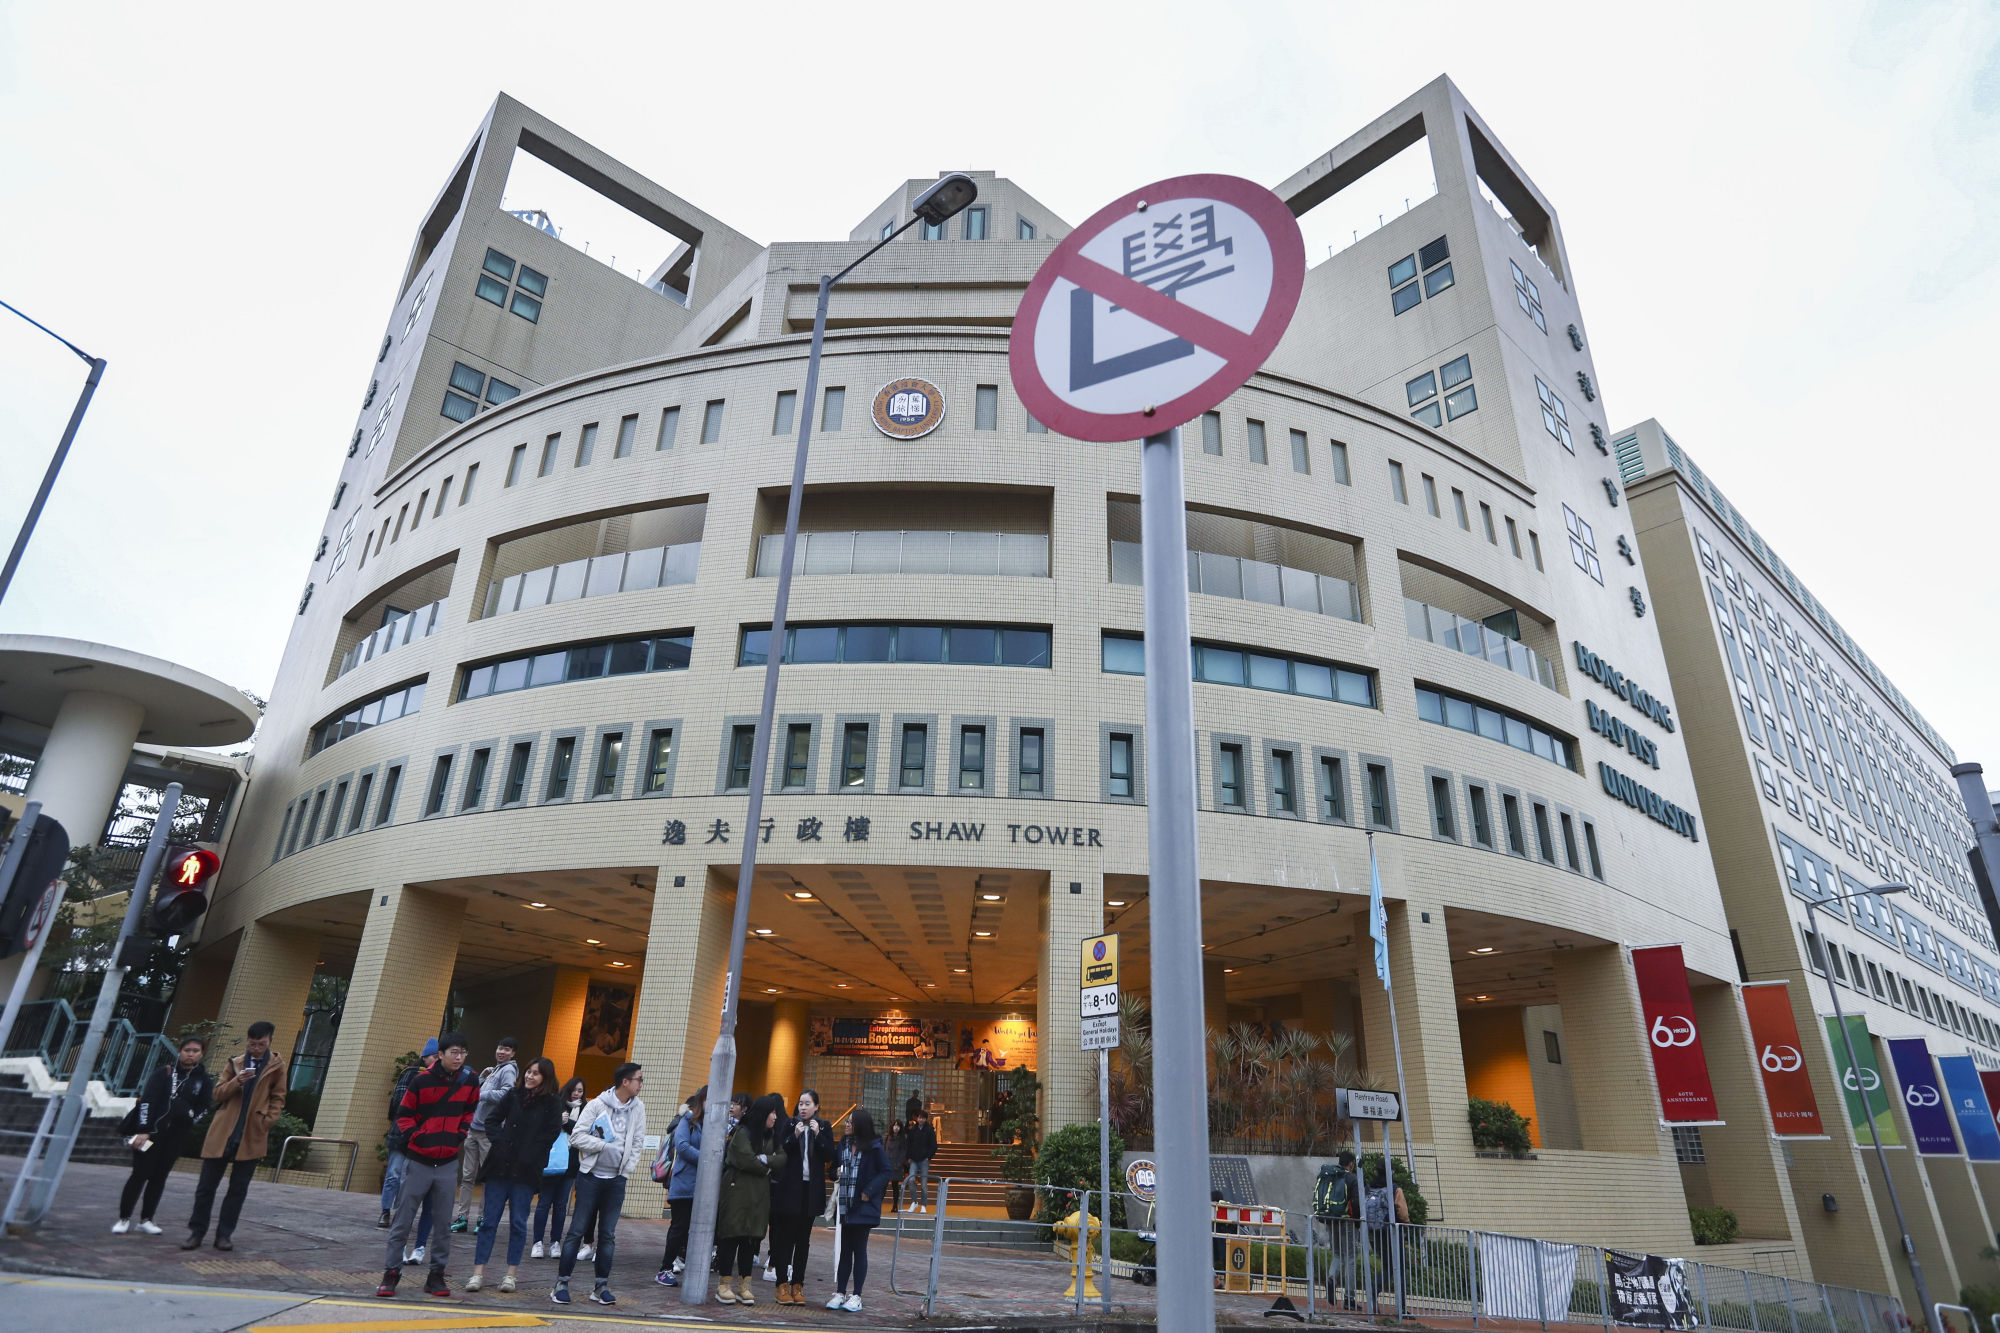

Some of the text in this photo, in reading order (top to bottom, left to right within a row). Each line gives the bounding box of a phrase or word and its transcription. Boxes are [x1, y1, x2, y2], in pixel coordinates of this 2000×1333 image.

[1574, 640, 1675, 733] HONG KONG
[1586, 699, 1660, 770] BAPTIST
[1598, 761, 1699, 842] UNIVERSITY
[910, 821, 1104, 847] SHAW TOWER
[1083, 1001, 1093, 1010] 下午
[1093, 992, 1117, 1008] 8-10
[869, 1025, 921, 1034] Entrepreneurship
[1083, 1027, 1118, 1036] General Holidays
[868, 1032, 921, 1047] Bootcamp
[1354, 1092, 1388, 1103] Renfrew Road
